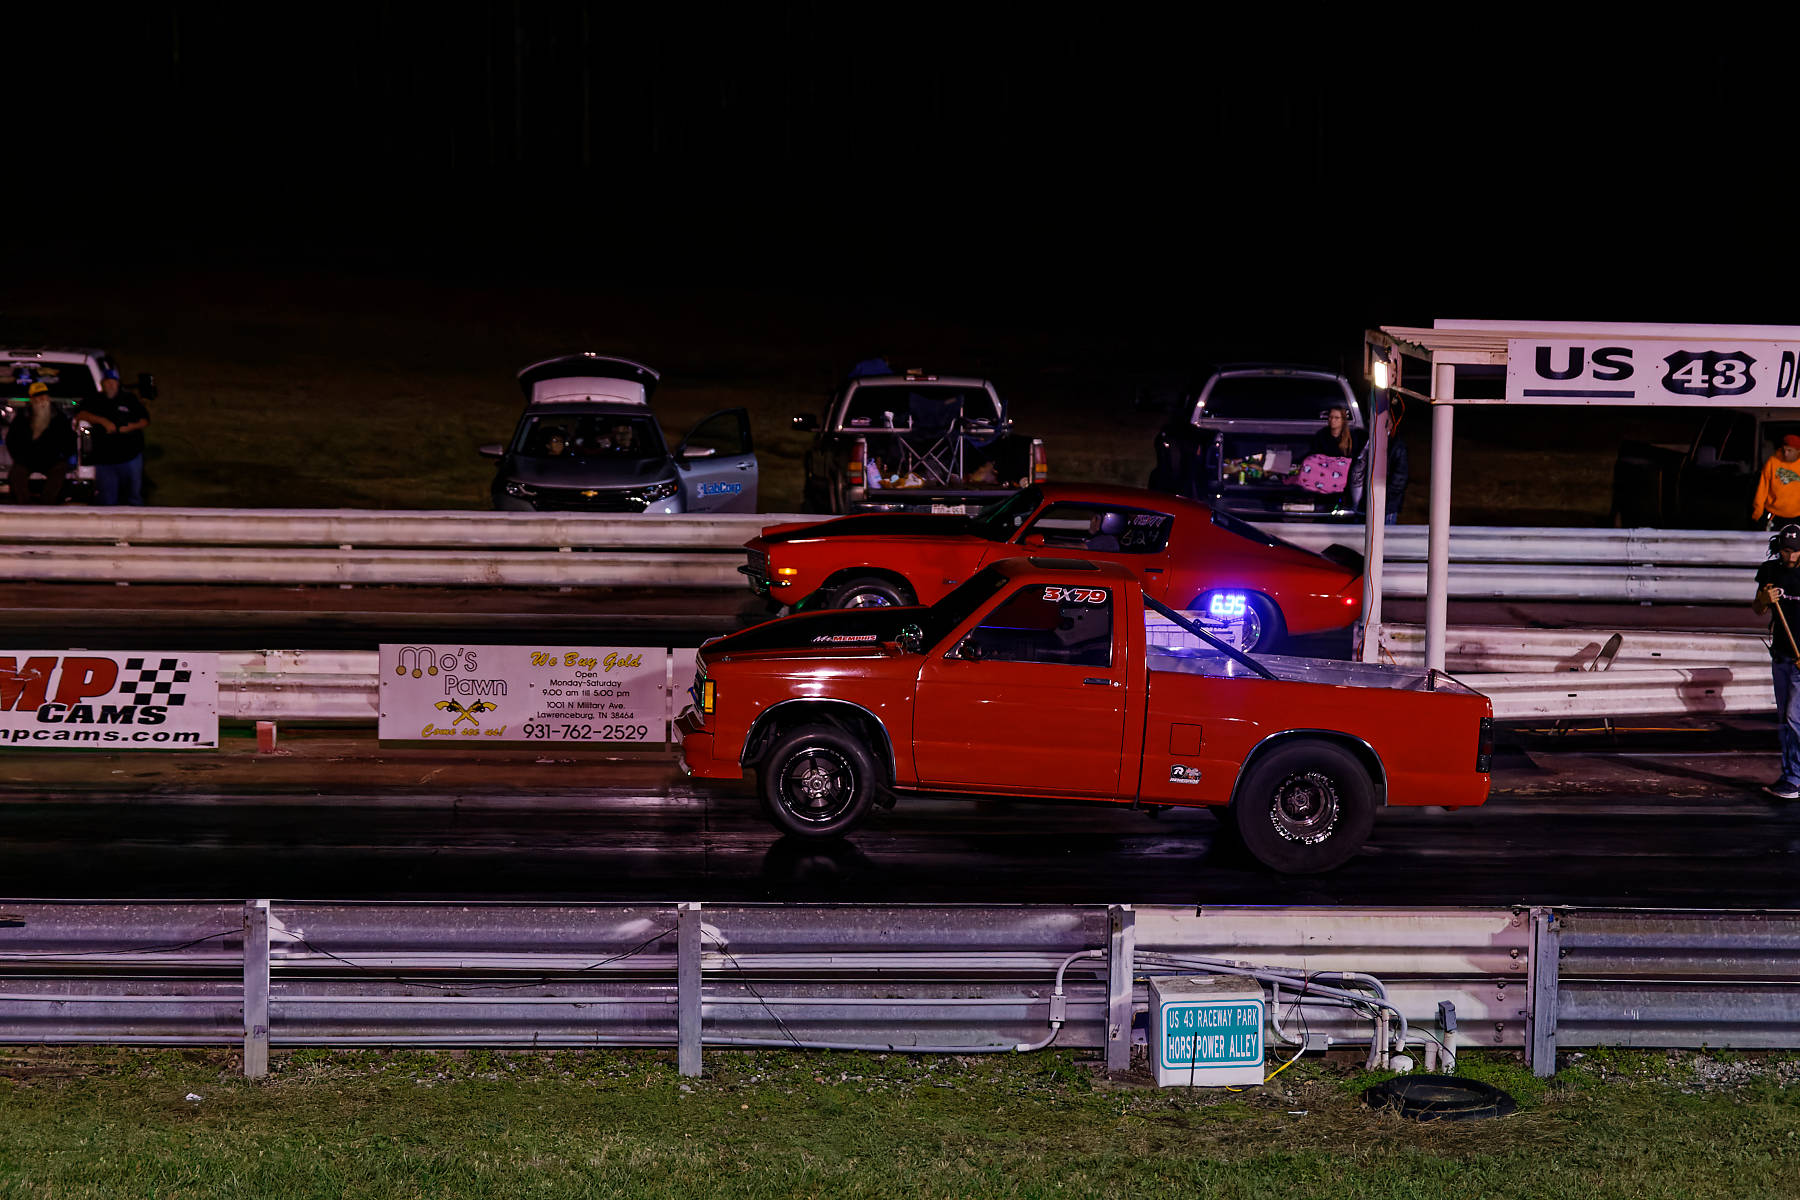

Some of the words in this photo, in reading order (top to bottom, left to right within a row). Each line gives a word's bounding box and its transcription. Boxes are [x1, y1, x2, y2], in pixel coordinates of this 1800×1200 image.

[1535, 346, 1634, 381] US
[1672, 359, 1747, 389] 43
[703, 482, 741, 495] LabCorp
[530, 651, 558, 667] We
[563, 651, 598, 671] Buy
[603, 652, 643, 672] Gold
[575, 670, 598, 679] Open
[444, 674, 508, 696] Pawn
[549, 680, 622, 688] Monday-Saturday
[616, 690, 630, 698] pm
[546, 701, 565, 709] 1001
[568, 701, 574, 709] N
[577, 701, 605, 710] Military
[36, 703, 168, 725] CAMS
[598, 711, 608, 719] TN
[610, 711, 634, 719] 38464
[421, 723, 456, 738] Come
[461, 728, 480, 736] see
[484, 725, 507, 736] us!
[522, 723, 648, 740] 931-762-2529
[1169, 1010, 1180, 1029] US
[1183, 1009, 1194, 1028] 43
[1197, 1008, 1233, 1028] RACEWAY
[1236, 1008, 1258, 1027] PARK
[1229, 1033, 1258, 1058] ALLEY
